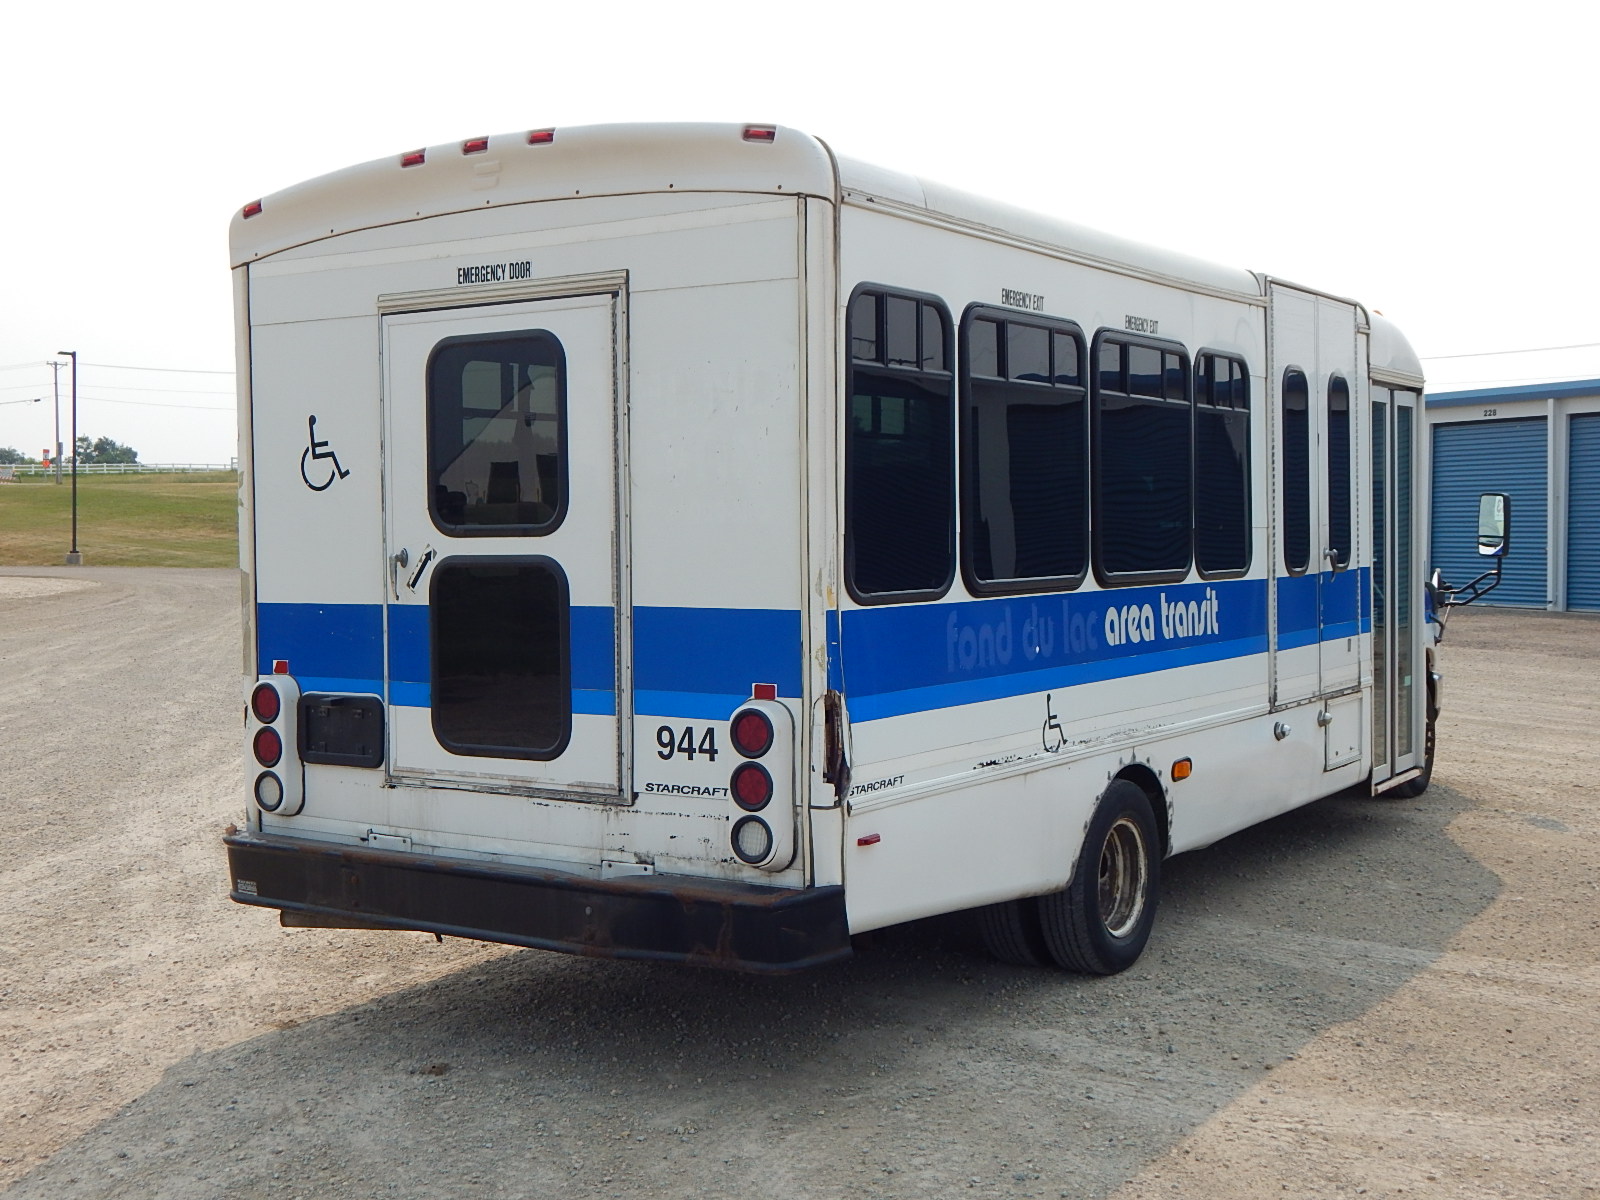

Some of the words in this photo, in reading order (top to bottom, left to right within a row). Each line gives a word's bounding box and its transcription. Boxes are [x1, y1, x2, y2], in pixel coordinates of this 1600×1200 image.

[457, 263, 506, 284] EMERGENCY
[509, 260, 531, 280] DOOR
[1001, 288, 1031, 309] EMERGENCY
[1033, 295, 1044, 311] EXIT
[1125, 315, 1148, 332] EMERGENCY
[1150, 320, 1158, 334] EXIT
[1483, 408, 1497, 417] 228
[946, 606, 1012, 673] fond
[1022, 602, 1053, 661] du
[1062, 599, 1098, 653] lac
[1105, 606, 1155, 646] area
[1160, 587, 1219, 639] transit
[656, 725, 719, 762] 944
[645, 782, 729, 797] STARCRAFT
